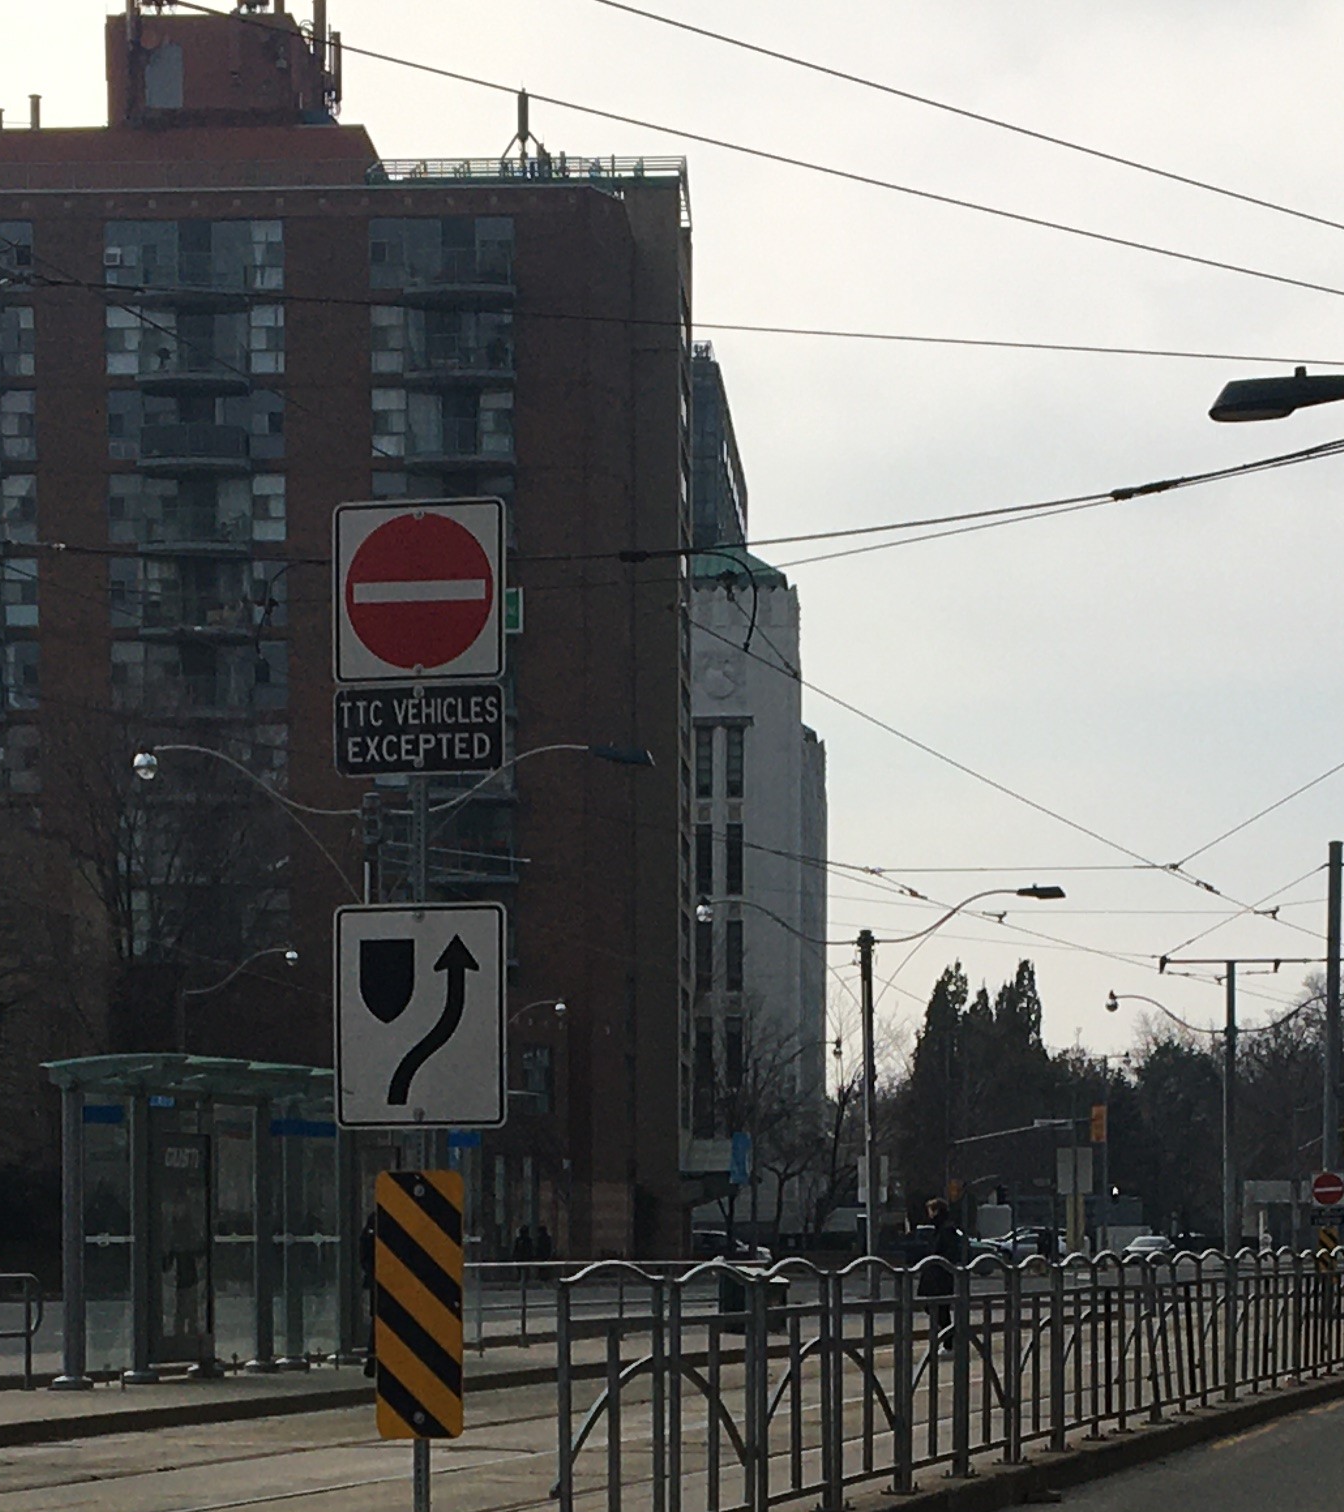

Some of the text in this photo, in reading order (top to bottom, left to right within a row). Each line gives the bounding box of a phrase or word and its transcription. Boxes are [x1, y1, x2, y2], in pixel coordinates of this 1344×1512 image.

[340, 695, 499, 729] TTC VEHICLES
[347, 731, 492, 763] EXCEPTED
